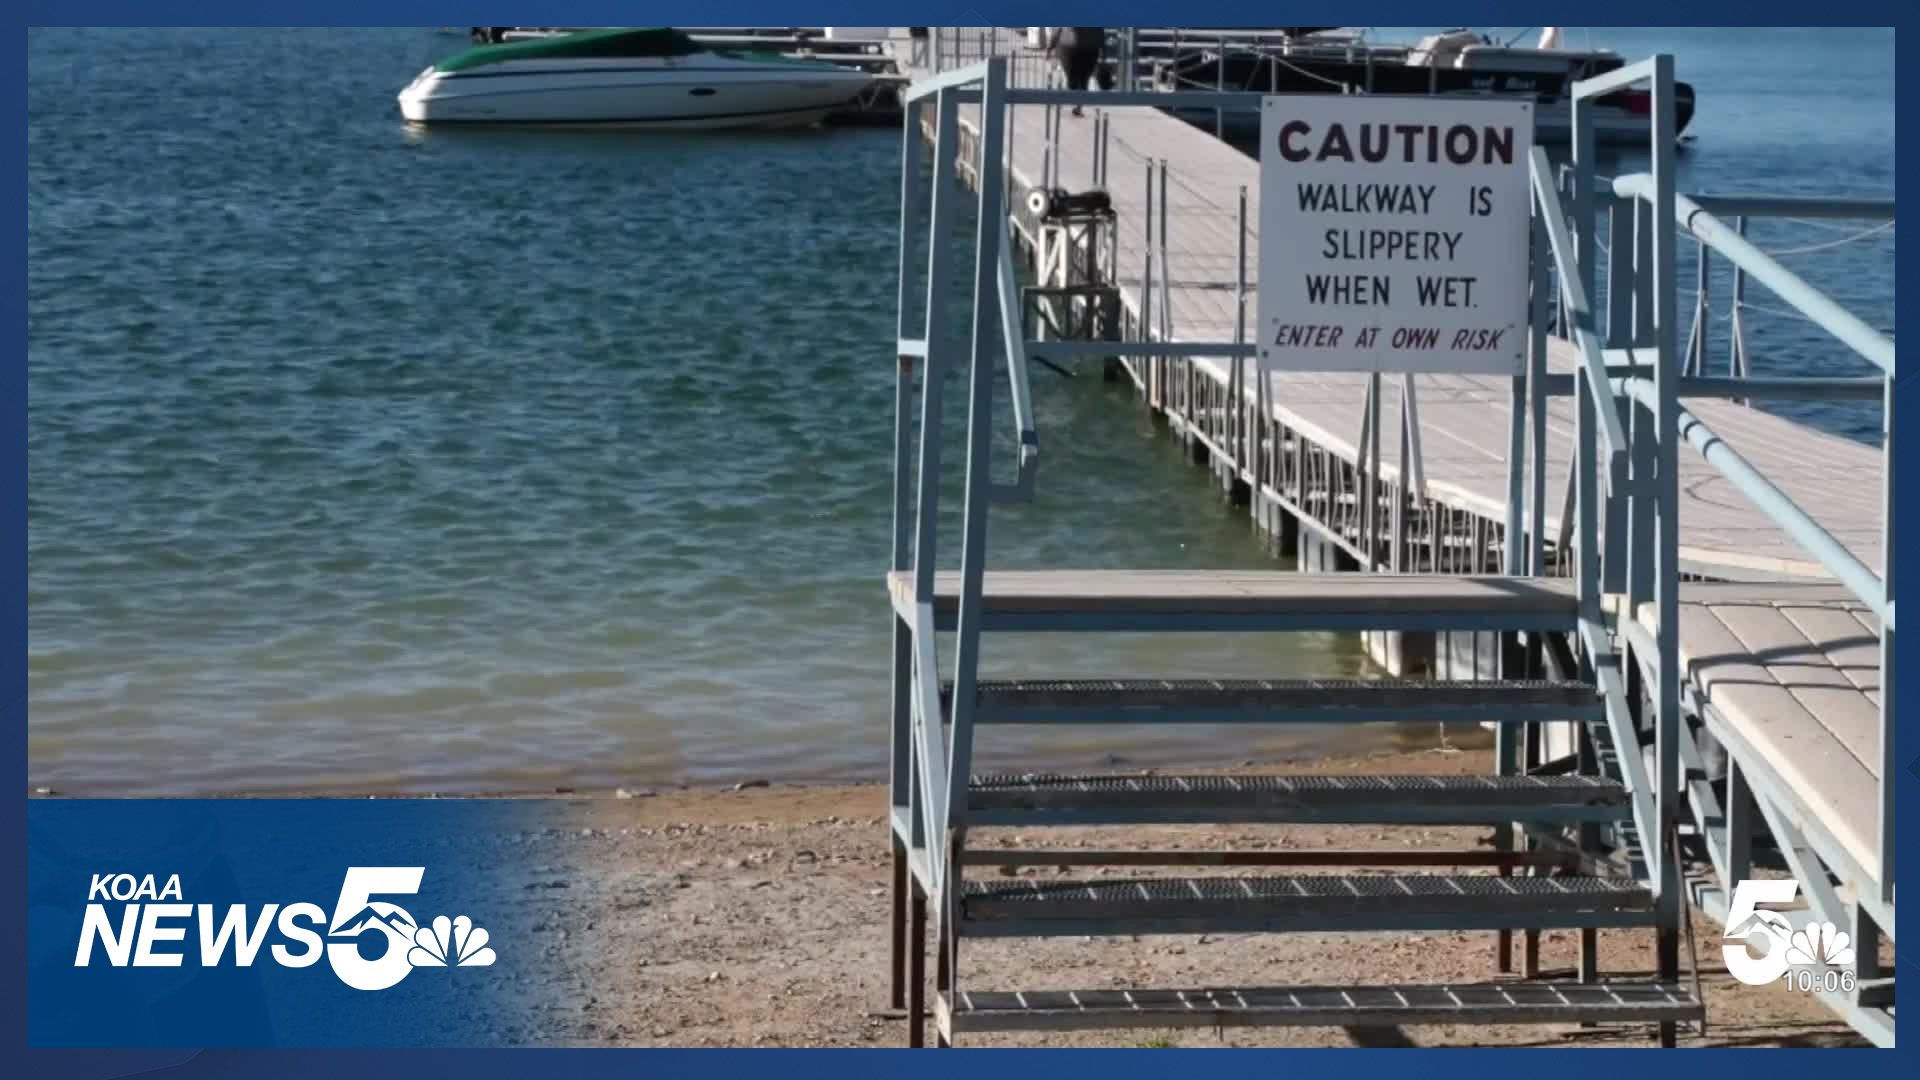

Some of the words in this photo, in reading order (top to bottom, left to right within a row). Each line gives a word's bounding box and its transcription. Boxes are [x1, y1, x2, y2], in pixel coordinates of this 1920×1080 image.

[1278, 120, 1514, 165] CAUTION
[1297, 183, 1436, 215] WALKWAY
[1469, 185, 1493, 216] IS
[1322, 229, 1463, 261] SLIPPERY
[1306, 274, 1390, 305] WHEN
[1416, 276, 1478, 308] WET.
[1355, 327, 1380, 348] AT
[1391, 327, 1440, 350] OWN
